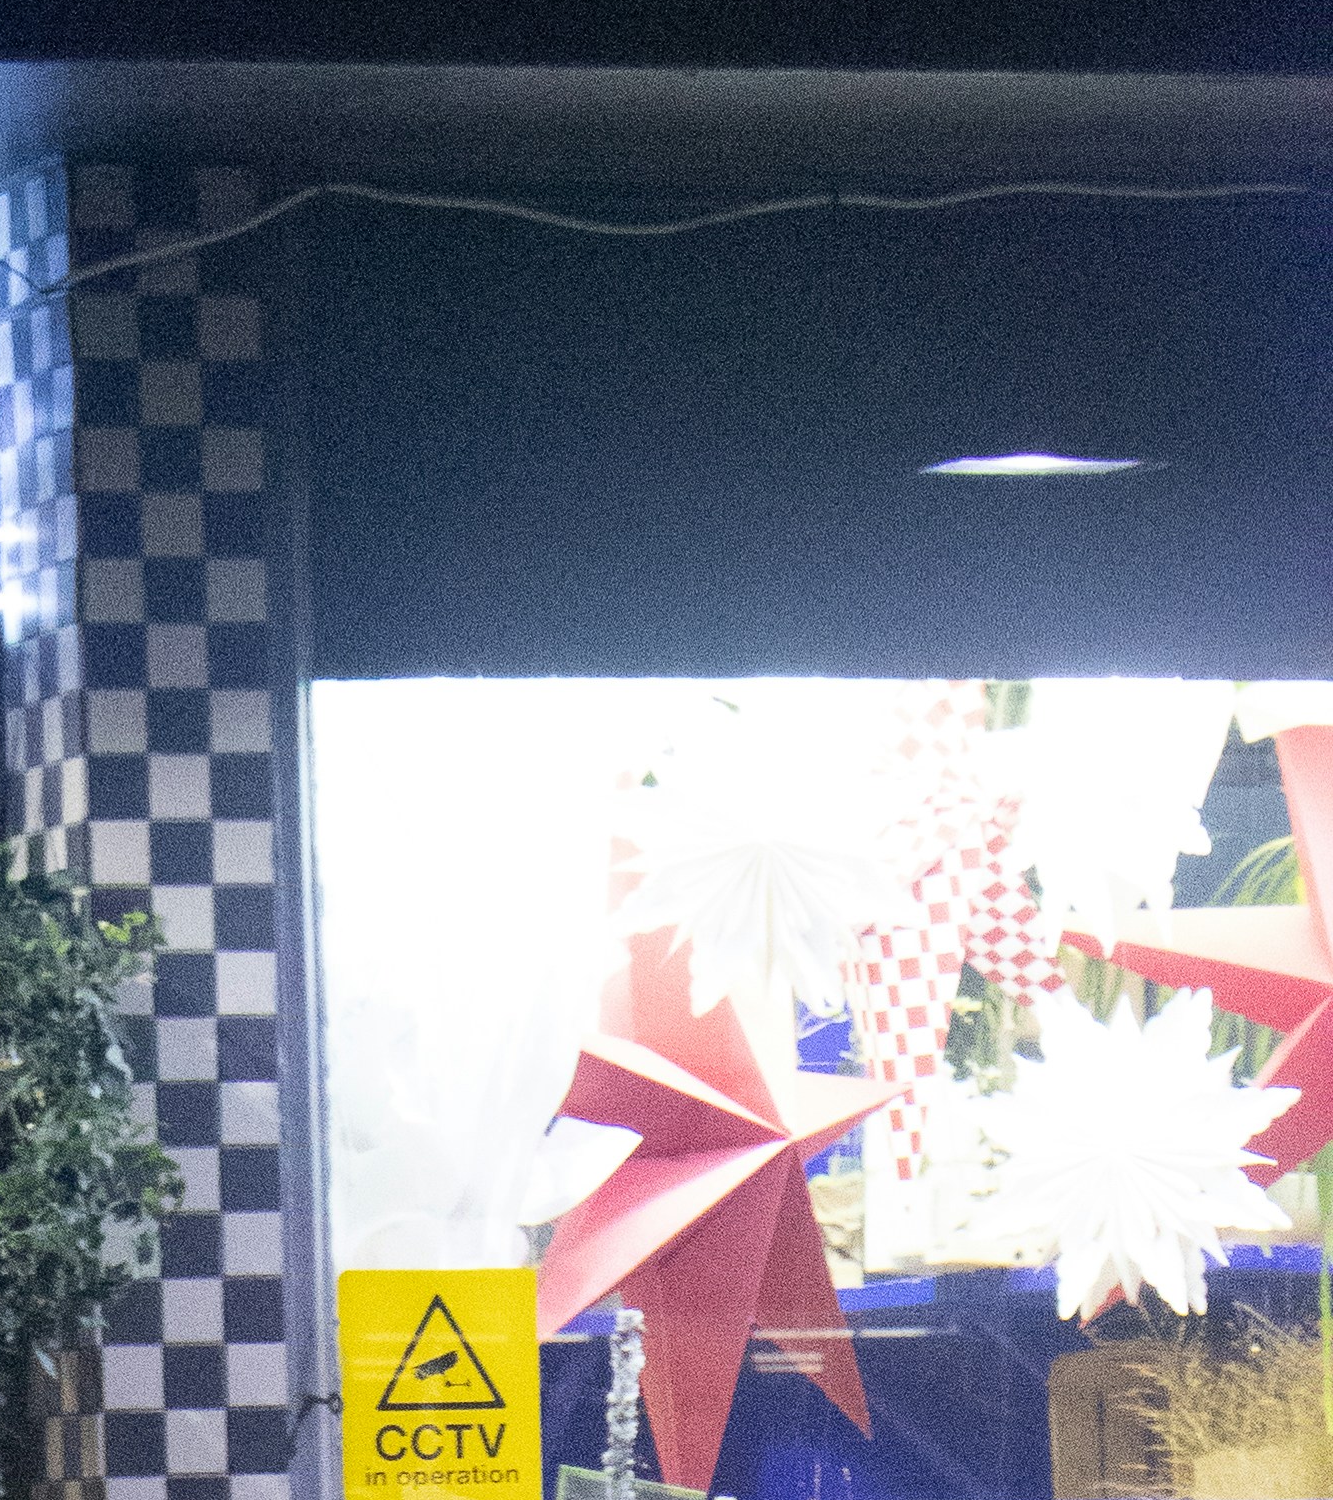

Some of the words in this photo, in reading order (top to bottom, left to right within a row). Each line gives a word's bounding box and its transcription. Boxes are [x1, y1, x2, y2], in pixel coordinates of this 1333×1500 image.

[375, 1422, 506, 1462] CCTV
[365, 1467, 387, 1486] in
[396, 1464, 520, 1486] operation
